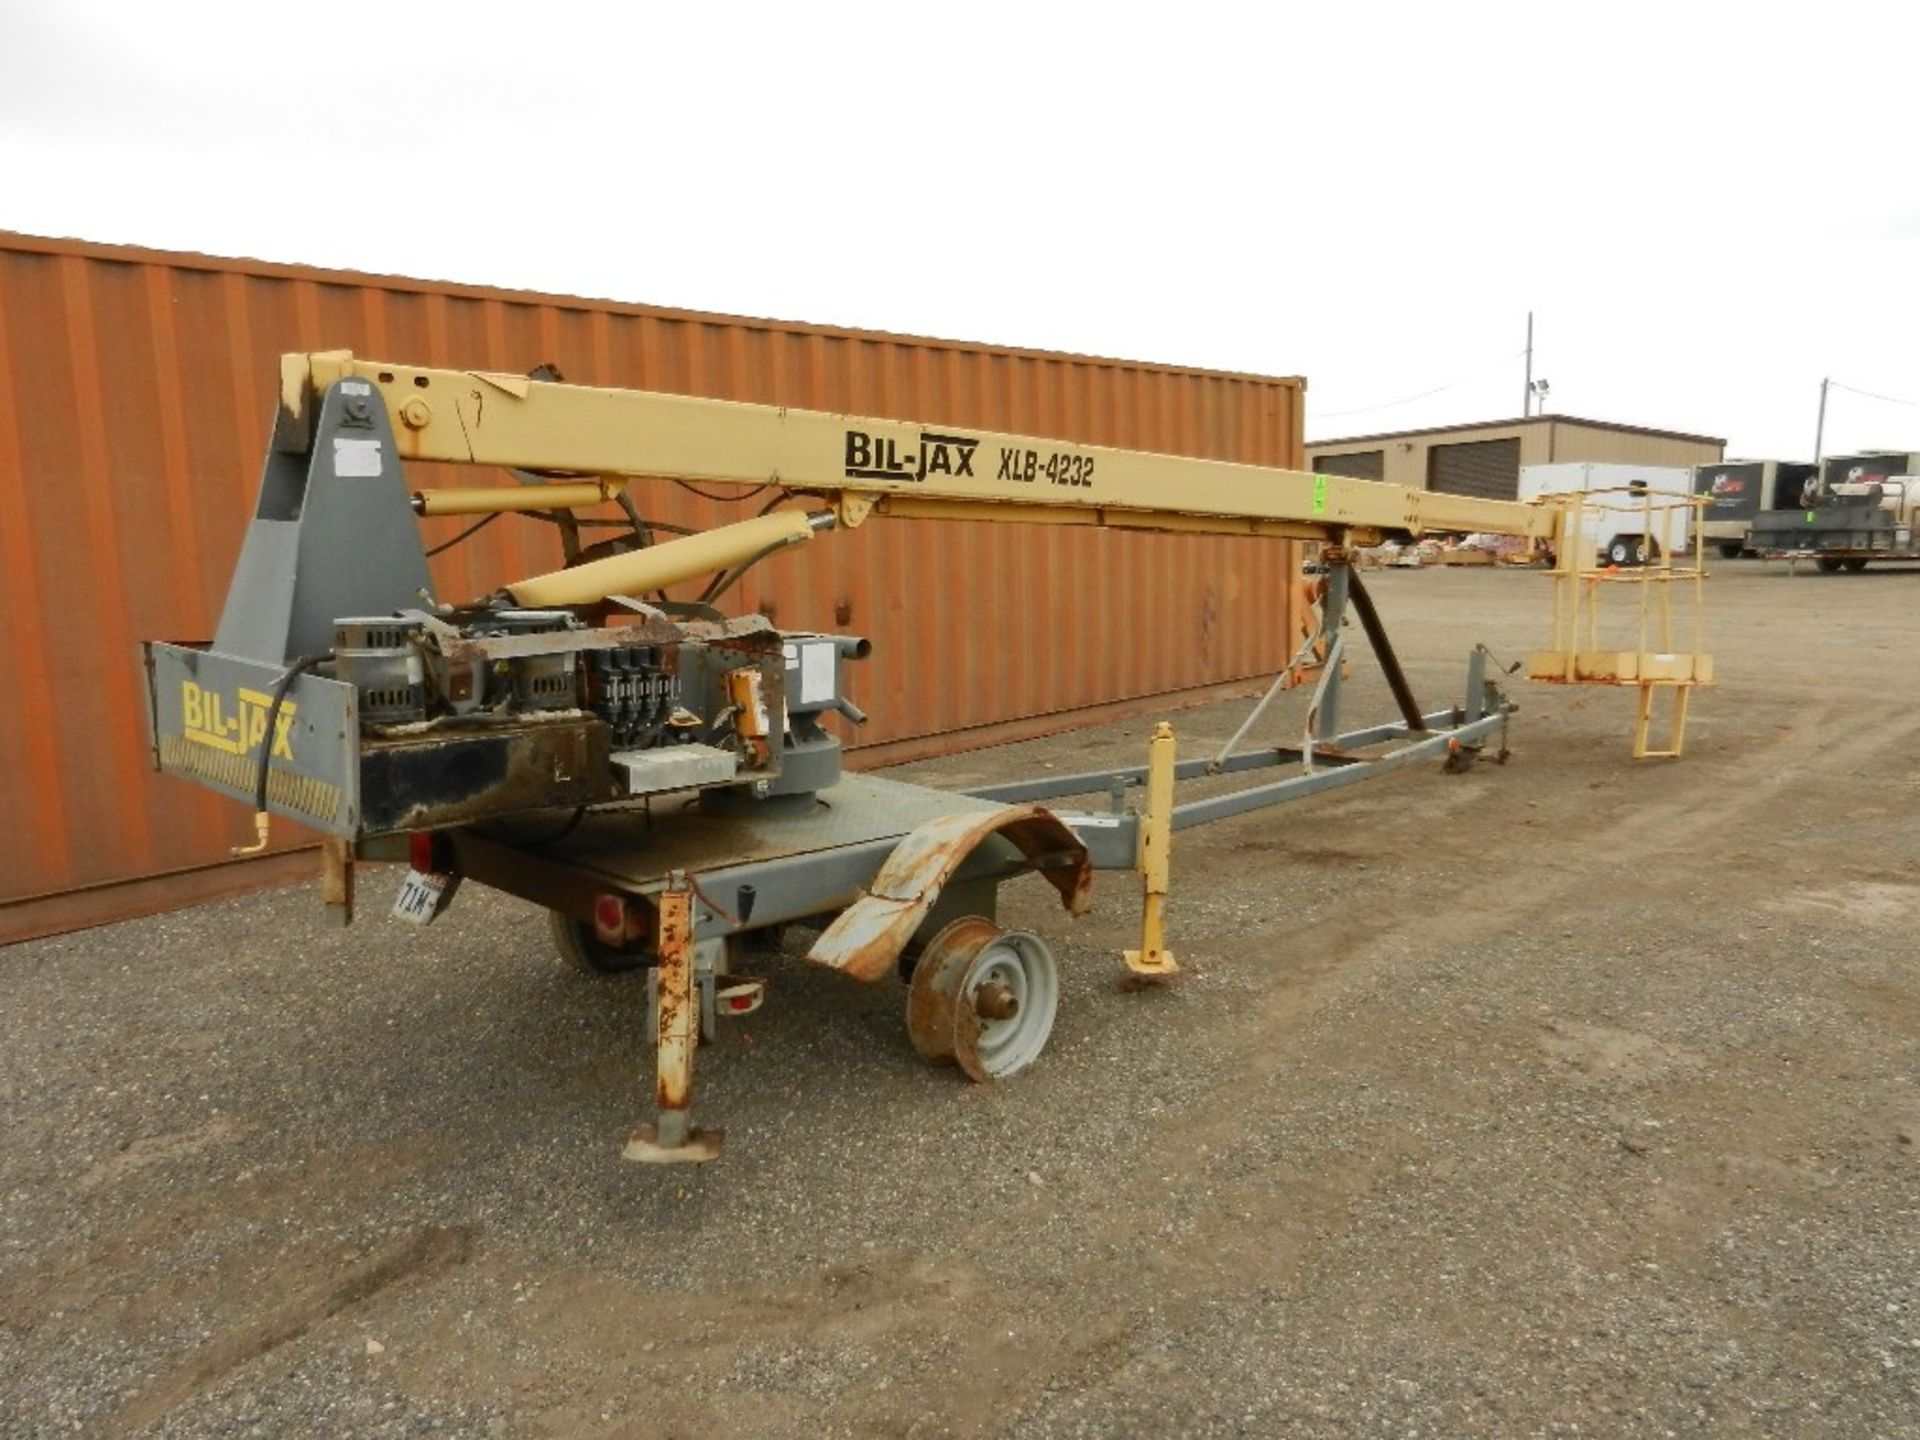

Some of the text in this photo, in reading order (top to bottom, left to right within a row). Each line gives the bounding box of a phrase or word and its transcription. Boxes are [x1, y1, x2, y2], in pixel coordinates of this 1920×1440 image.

[845, 431, 1094, 487] BIL-JAX XLB-4232
[183, 680, 297, 761] BIL-JAX
